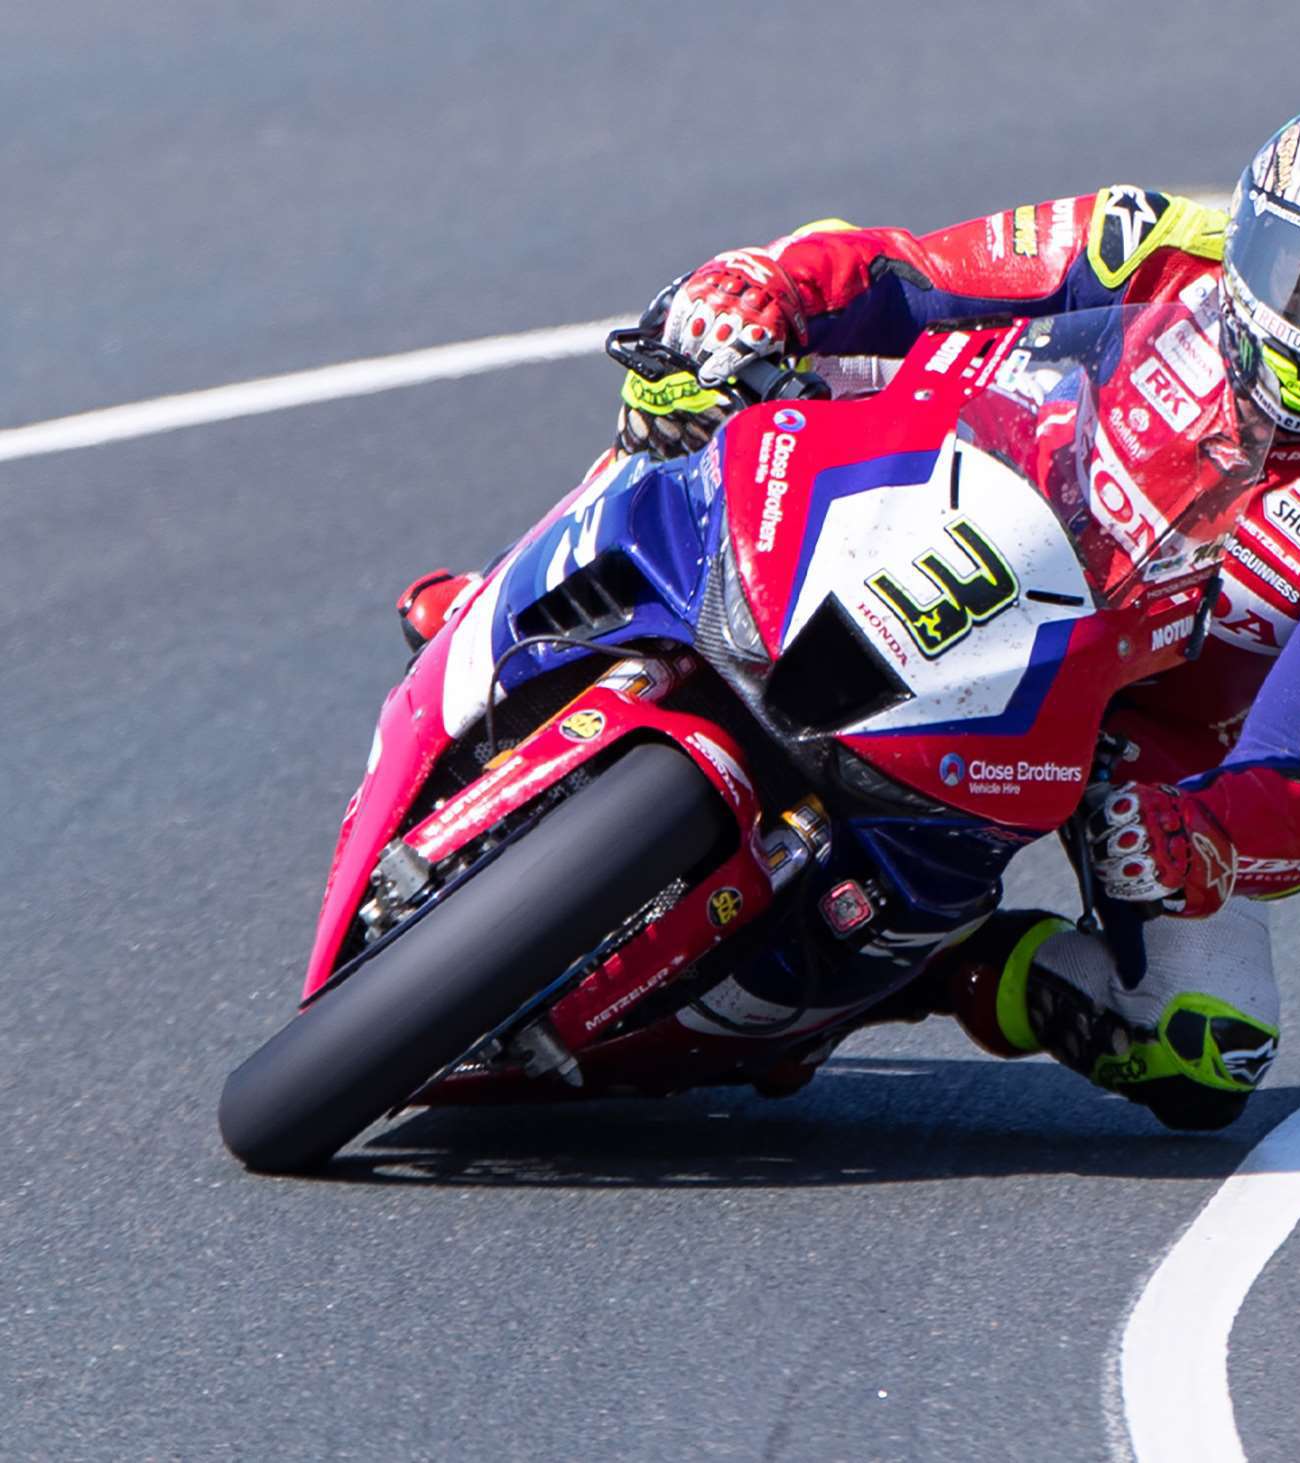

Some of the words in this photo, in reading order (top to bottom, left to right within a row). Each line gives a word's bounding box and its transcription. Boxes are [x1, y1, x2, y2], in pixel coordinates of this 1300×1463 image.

[1144, 368, 1187, 417] RK
[769, 433, 797, 479] Close
[757, 480, 789, 553] Brothers
[864, 514, 1019, 661] 3
[1223, 534, 1300, 604] McGUINNESS
[856, 603, 909, 667] HONDA
[1151, 615, 1195, 651] MOTU
[968, 760, 1014, 781] Close
[1017, 761, 1083, 782] Brothers
[968, 782, 1001, 794] Vehicle
[1002, 784, 1021, 795] Hire
[584, 967, 669, 1031] METZELER
